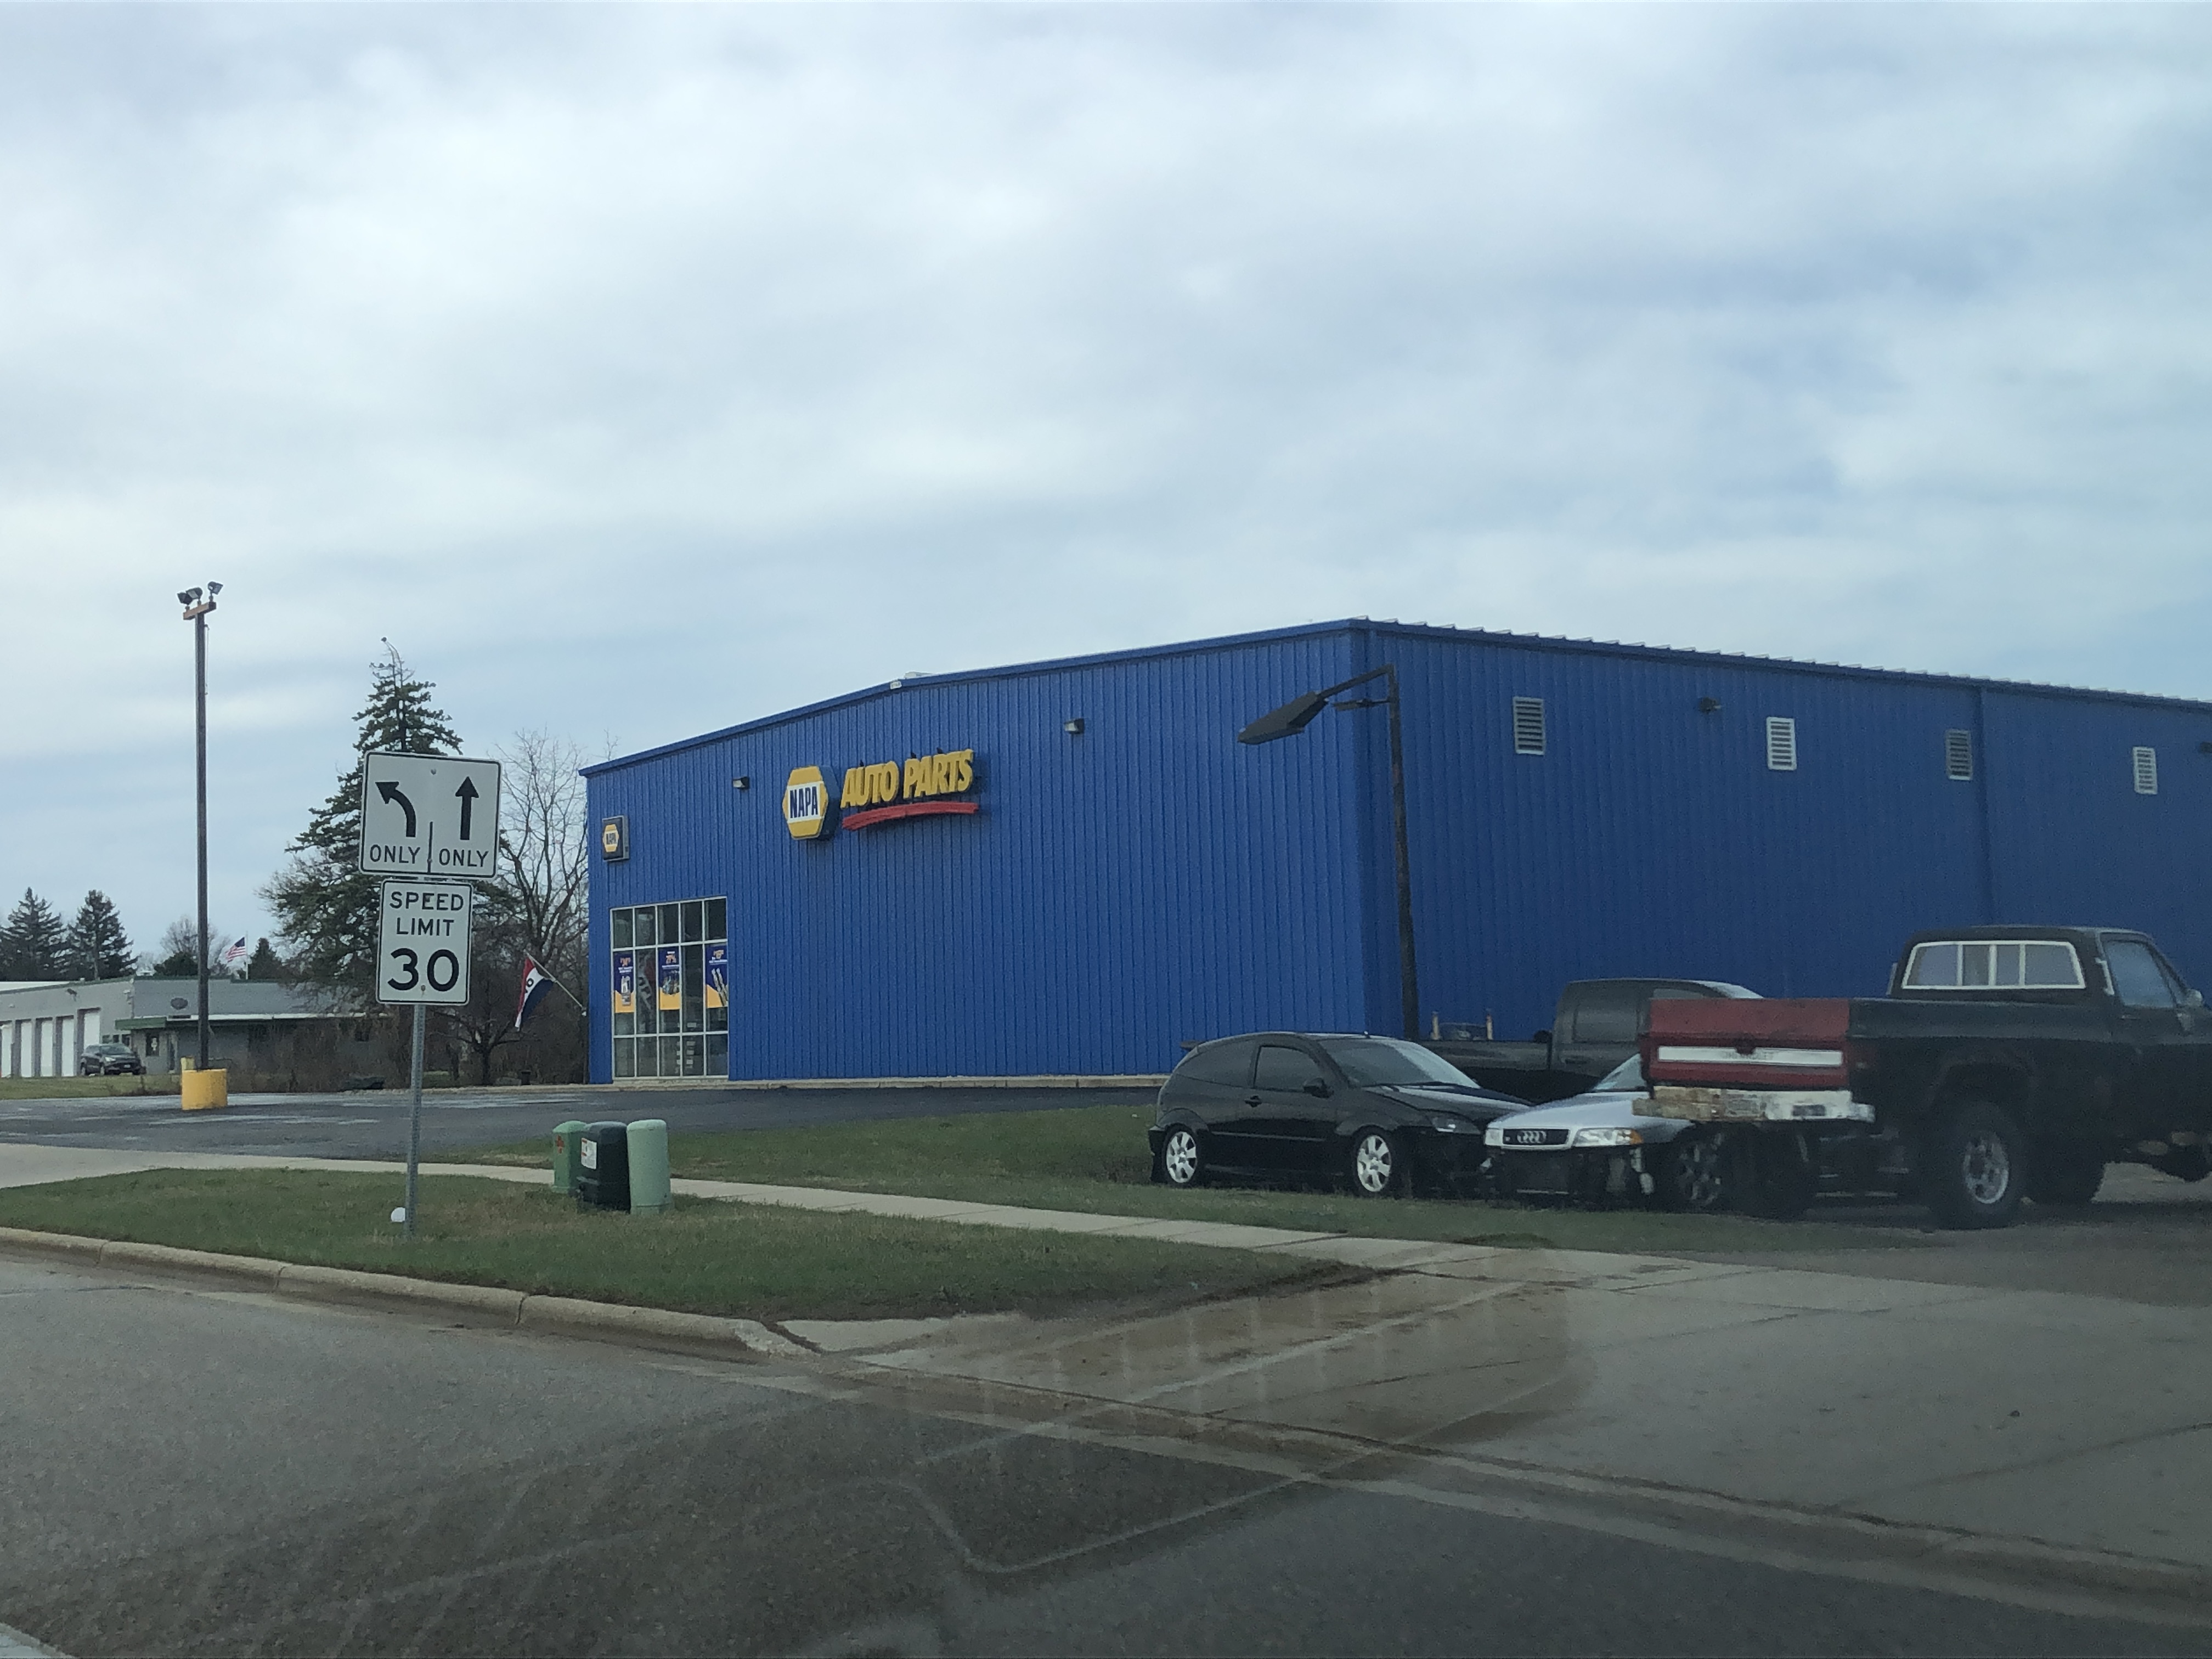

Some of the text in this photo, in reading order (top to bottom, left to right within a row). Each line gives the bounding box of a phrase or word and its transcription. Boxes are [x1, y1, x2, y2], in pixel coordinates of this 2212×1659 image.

[789, 748, 973, 819] NAPA AUTO PARTS
[370, 845, 489, 867] ONLY ONLY
[389, 891, 464, 911] SPEED
[397, 917, 454, 936] LIMIT
[387, 947, 459, 992] 30
